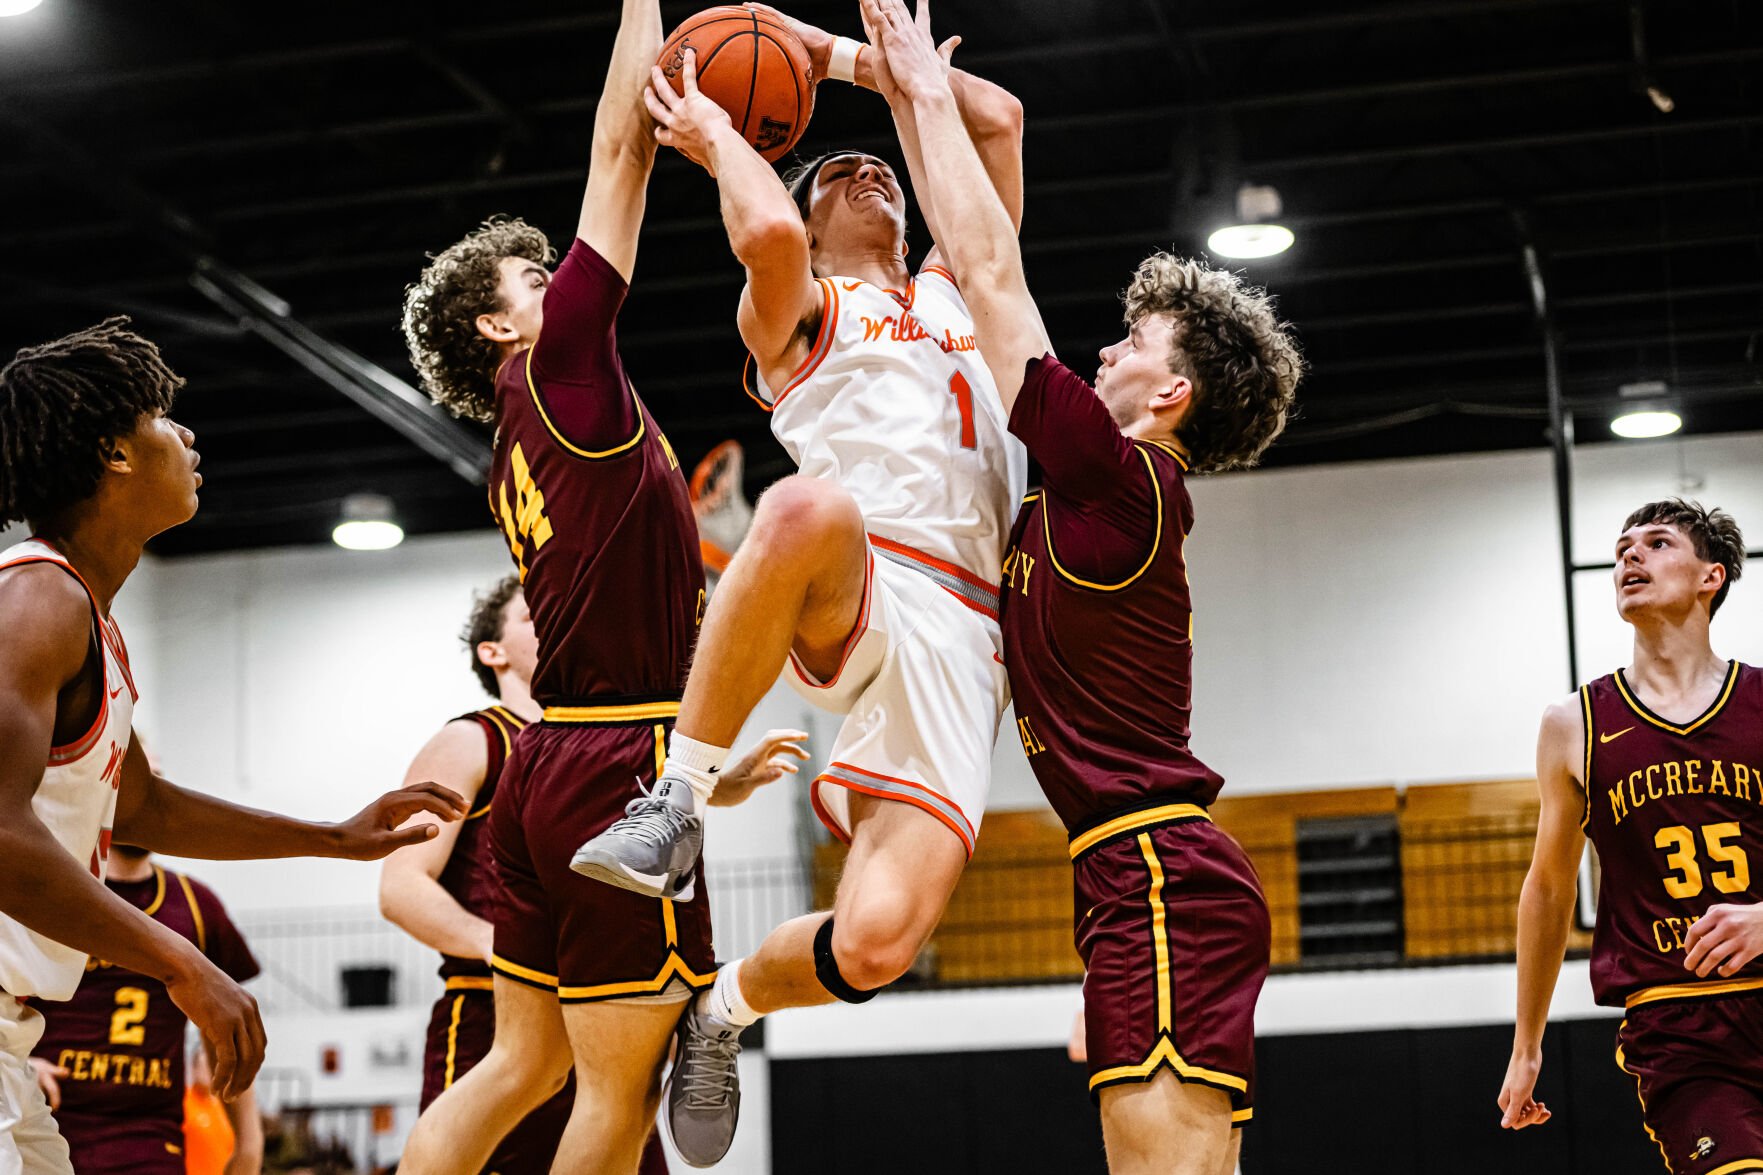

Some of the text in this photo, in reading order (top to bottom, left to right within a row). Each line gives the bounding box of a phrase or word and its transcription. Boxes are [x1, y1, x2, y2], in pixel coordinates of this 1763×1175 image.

[947, 368, 977, 451] 1
[1654, 821, 1750, 900] 35
[109, 986, 149, 1046] 2
[58, 1049, 172, 1089] CENTRAL
